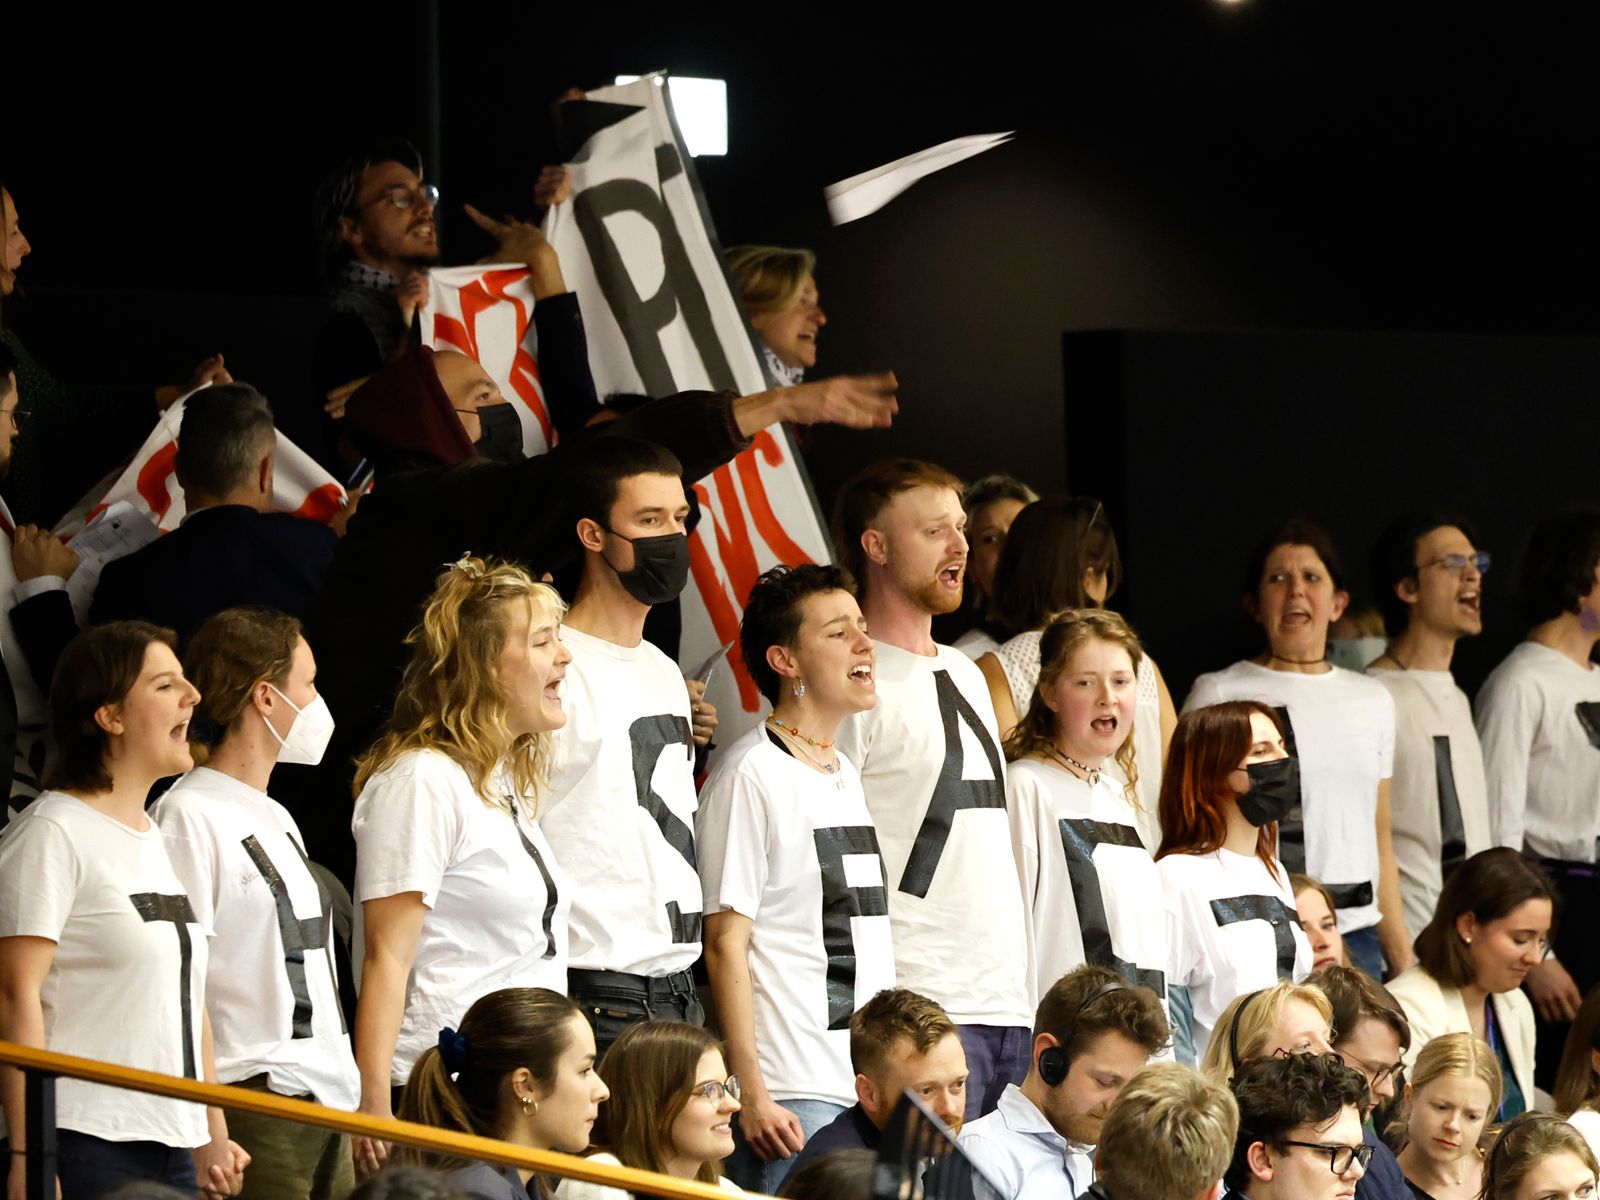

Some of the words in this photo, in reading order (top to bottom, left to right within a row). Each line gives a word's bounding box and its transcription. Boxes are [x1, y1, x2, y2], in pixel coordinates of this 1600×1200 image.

[629, 714, 702, 943] S
[898, 669, 1006, 898] A
[129, 893, 198, 1079] T
[241, 832, 349, 1039] H
[1209, 894, 1305, 983] T
